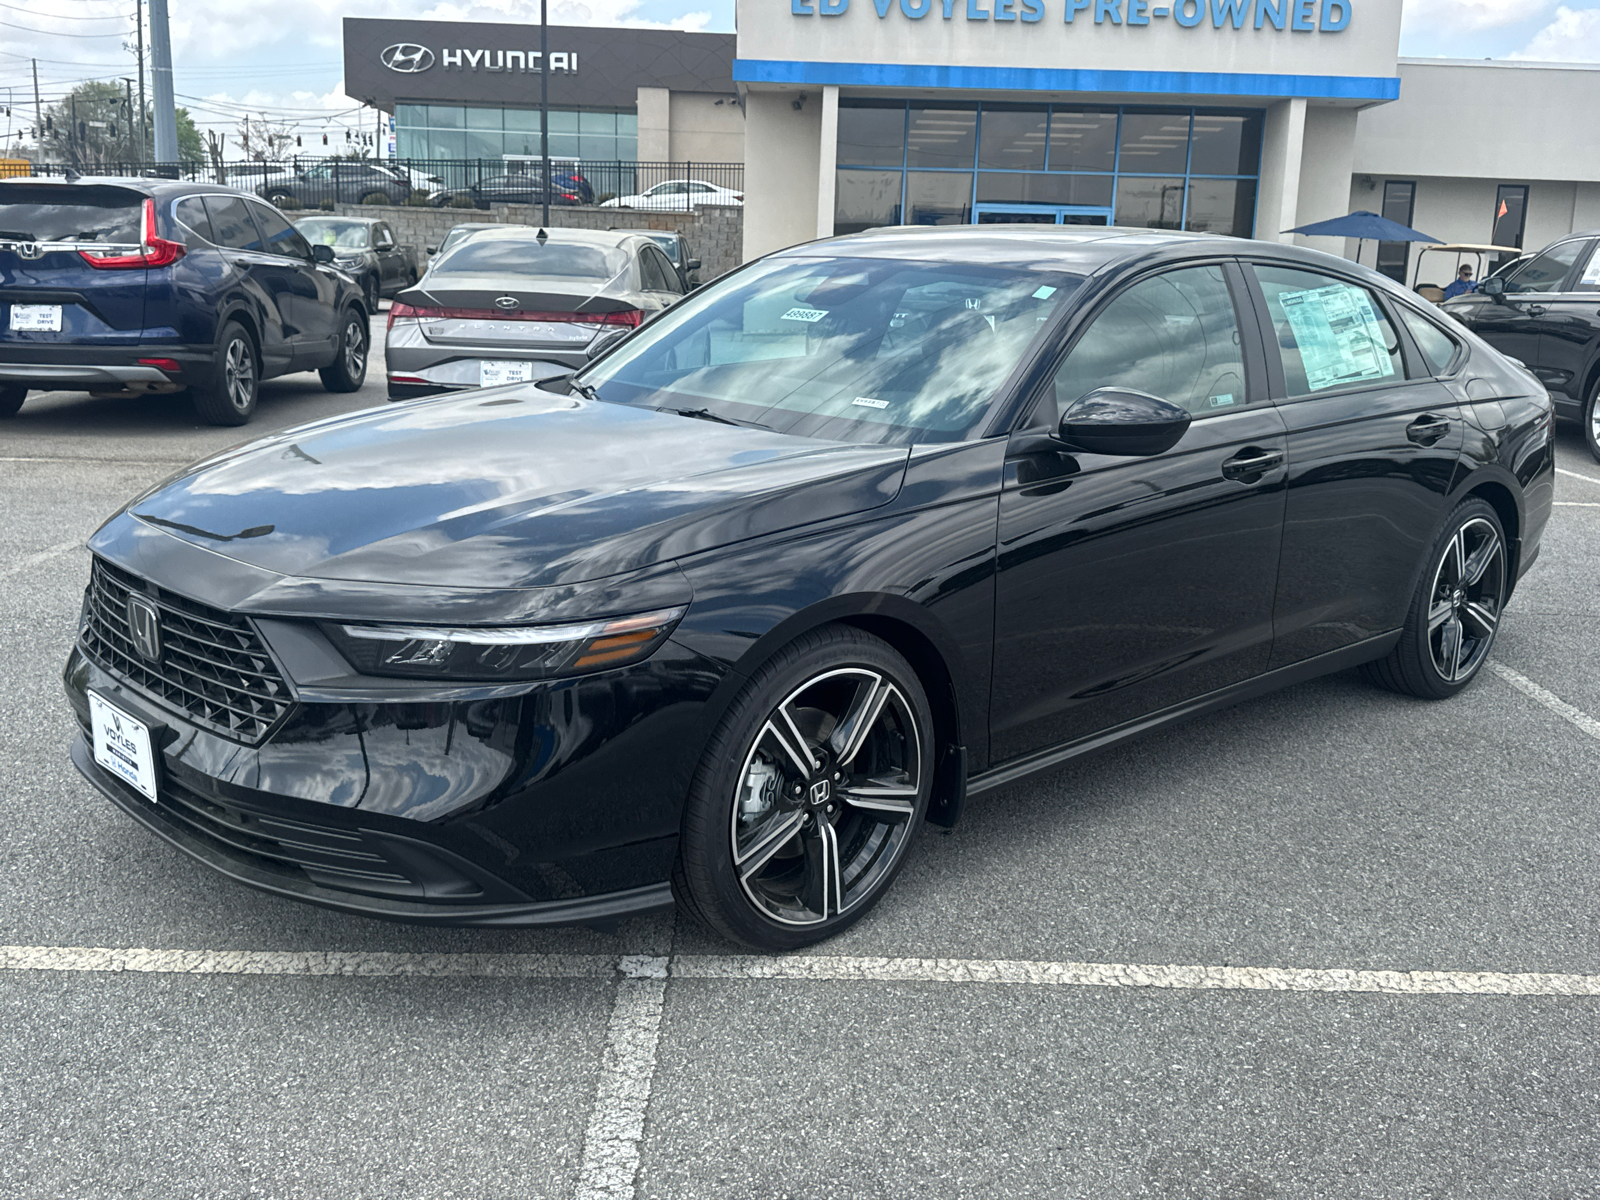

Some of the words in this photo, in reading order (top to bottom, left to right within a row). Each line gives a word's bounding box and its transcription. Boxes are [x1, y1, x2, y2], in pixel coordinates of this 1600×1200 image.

[1064, 0, 1352, 32] PRE-OWNED
[442, 48, 578, 74] HYUNDAI
[459, 323, 555, 331] ELANTRA
[103, 723, 137, 755] VOYLES
